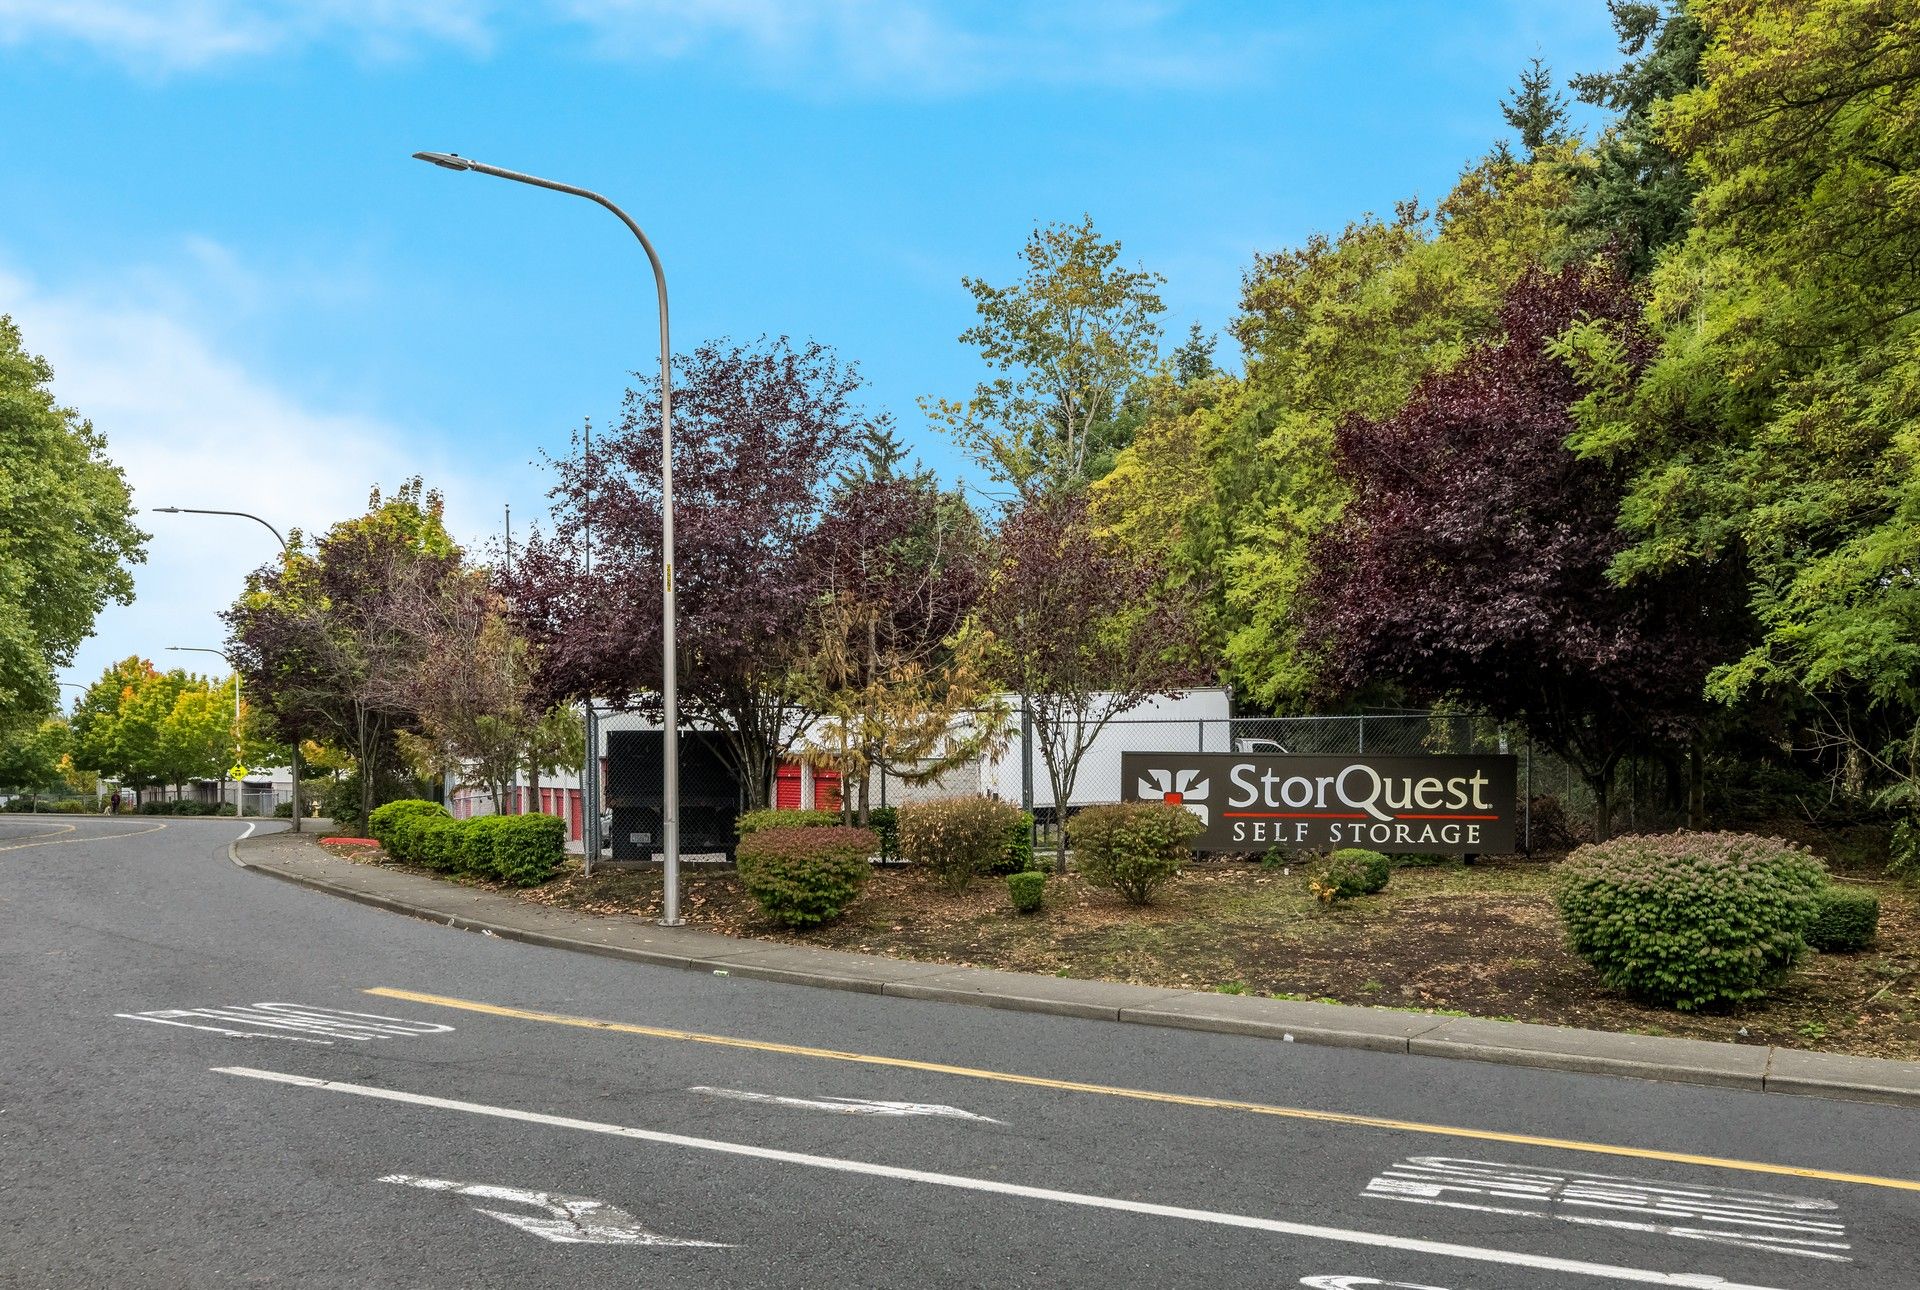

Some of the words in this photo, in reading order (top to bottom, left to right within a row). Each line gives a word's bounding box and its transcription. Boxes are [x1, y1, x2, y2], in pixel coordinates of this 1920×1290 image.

[1228, 764, 1490, 821] StorQuest
[1233, 822, 1309, 842] SELF
[1330, 824, 1481, 844] STORAGE
[1360, 1156, 1854, 1262] ONLY
